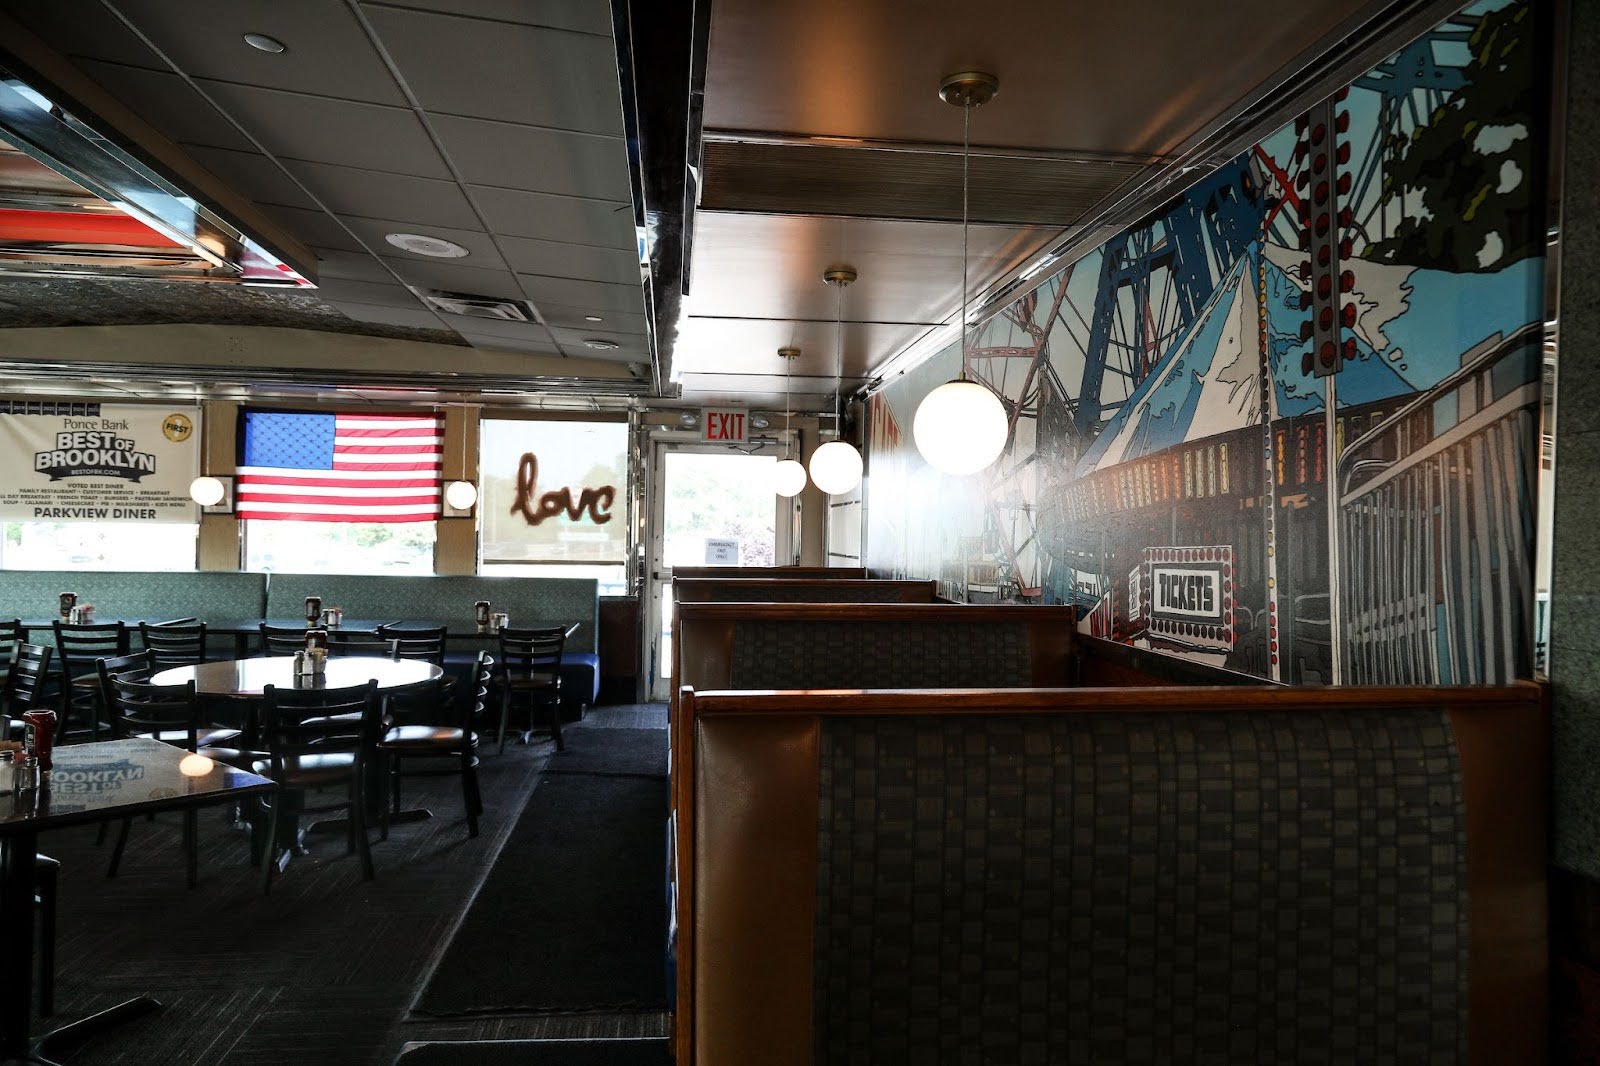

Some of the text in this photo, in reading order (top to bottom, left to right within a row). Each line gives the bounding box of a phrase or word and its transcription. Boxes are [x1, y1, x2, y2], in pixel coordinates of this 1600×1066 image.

[64, 418, 129, 430] Ponce Bank
[166, 423, 188, 433] FIRST
[708, 412, 745, 440] EXIT
[57, 431, 134, 451] BEST OF
[36, 449, 155, 472] BROOKLYN
[510, 452, 616, 526] love
[34, 507, 156, 519] PARKVIEW DINER
[1159, 573, 1213, 611] TICKETS
